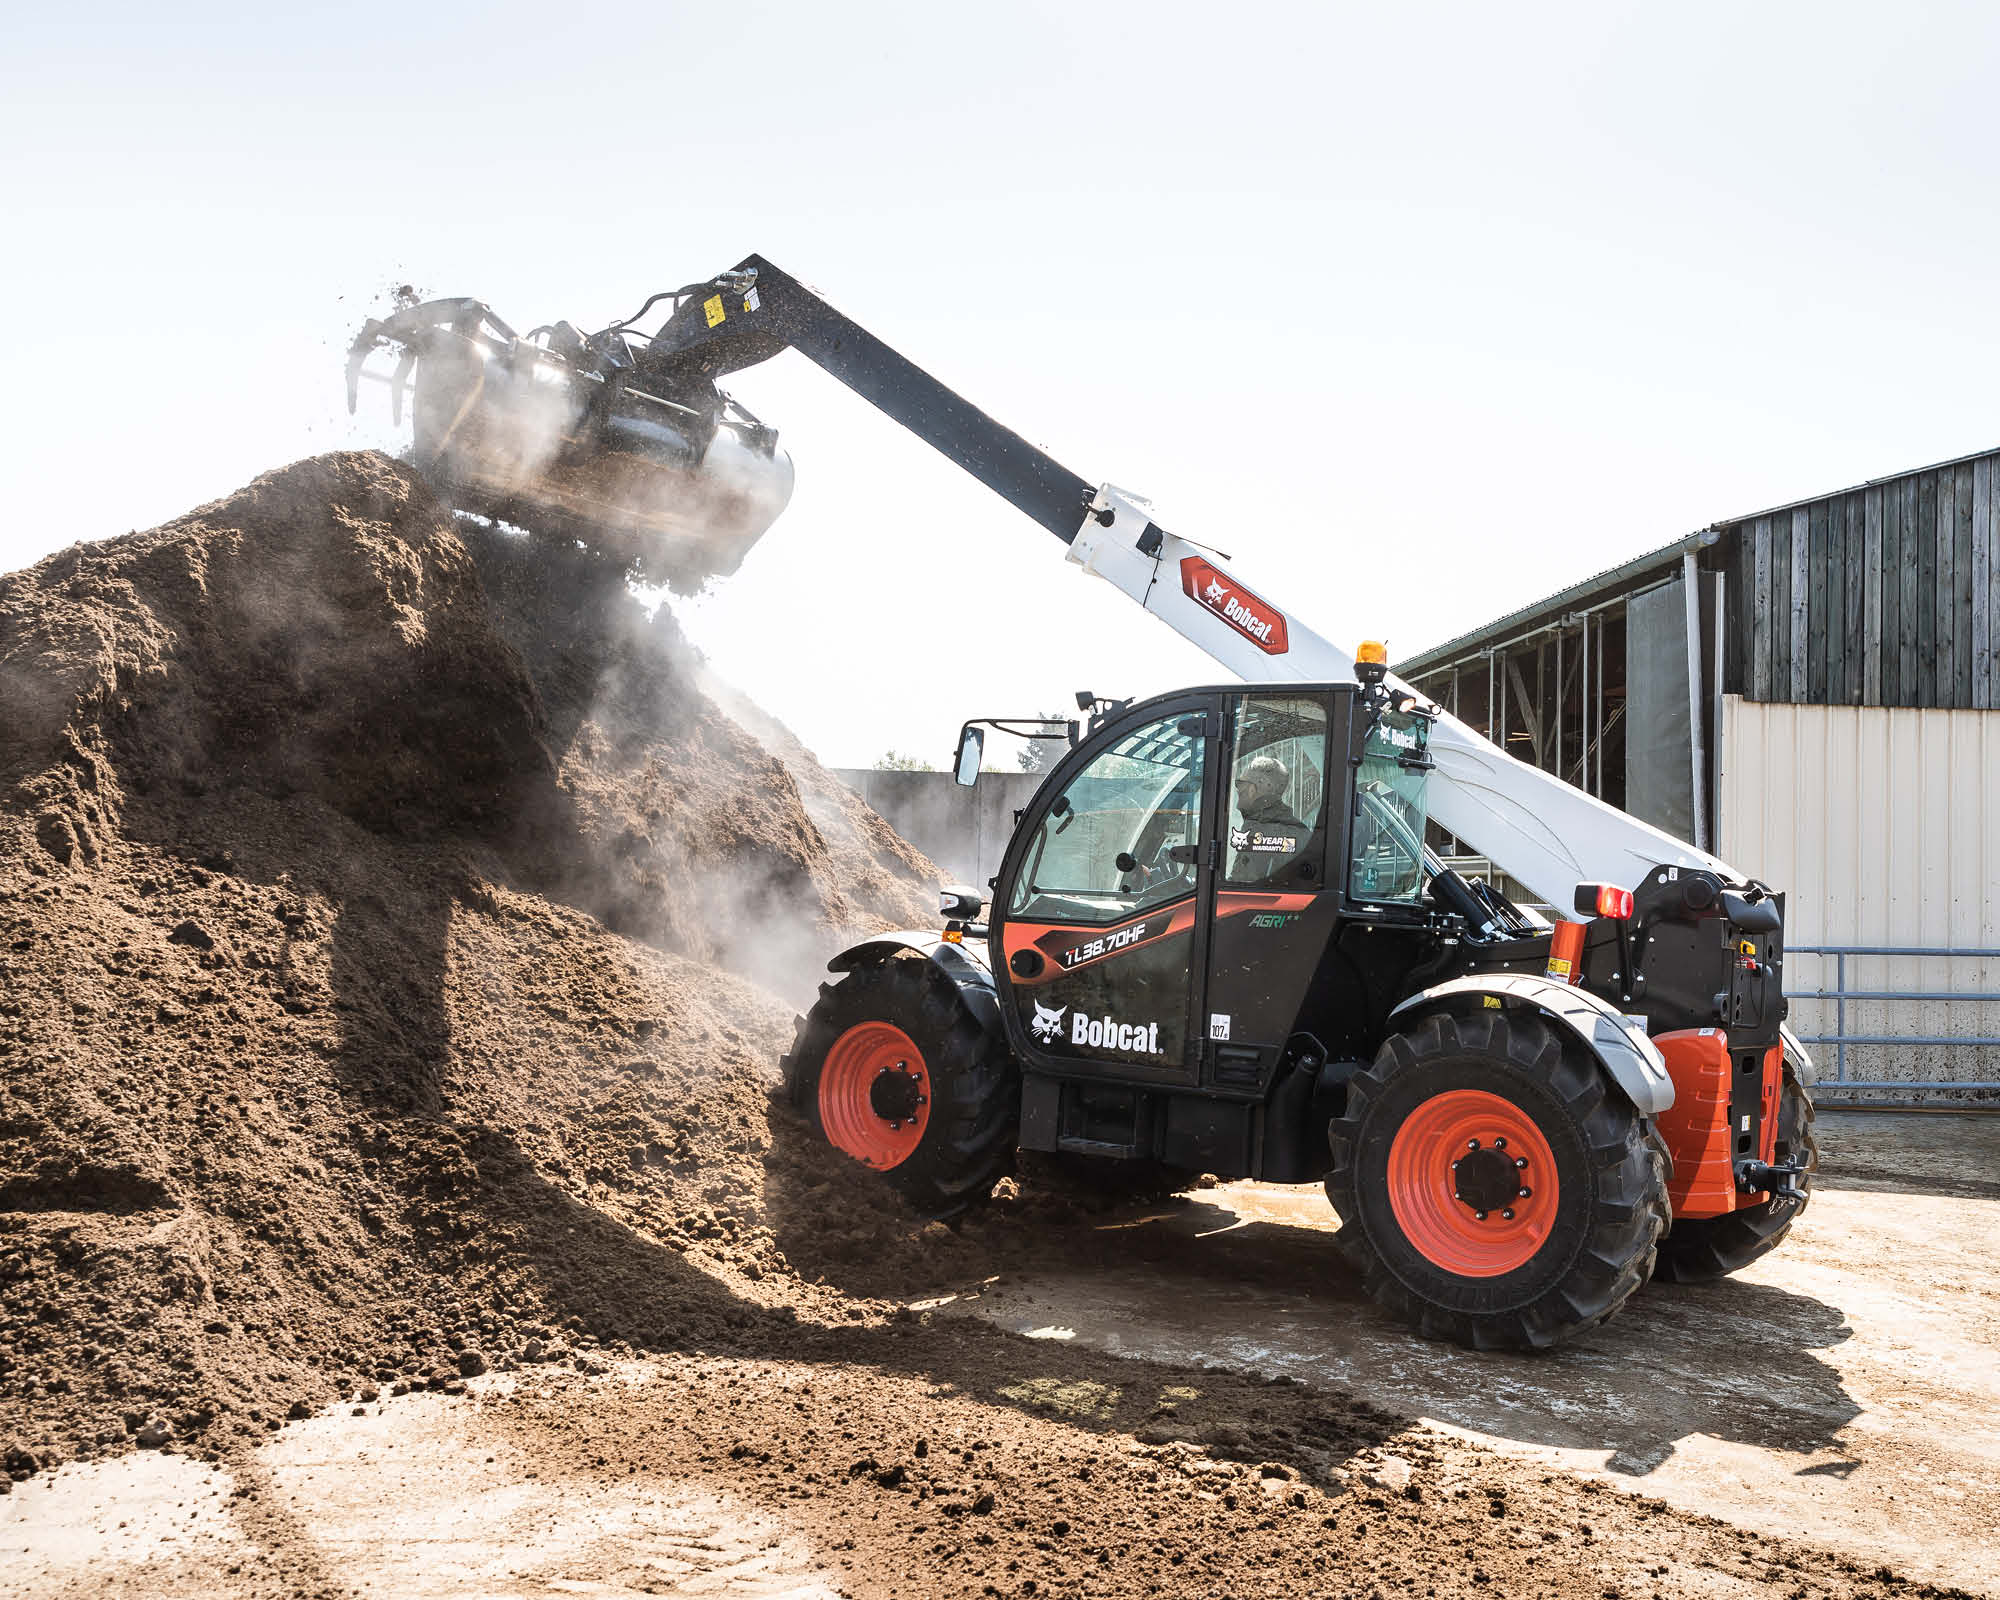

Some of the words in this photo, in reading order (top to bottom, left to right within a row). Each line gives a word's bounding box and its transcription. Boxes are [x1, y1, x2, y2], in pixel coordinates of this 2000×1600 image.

[1223, 596, 1272, 642] Bobcat
[1391, 728, 1417, 750] Bobcat
[1065, 922, 1146, 966] TL38.70HF
[1071, 1012, 1159, 1054] Bobcat
[1211, 1024, 1225, 1038] 107
